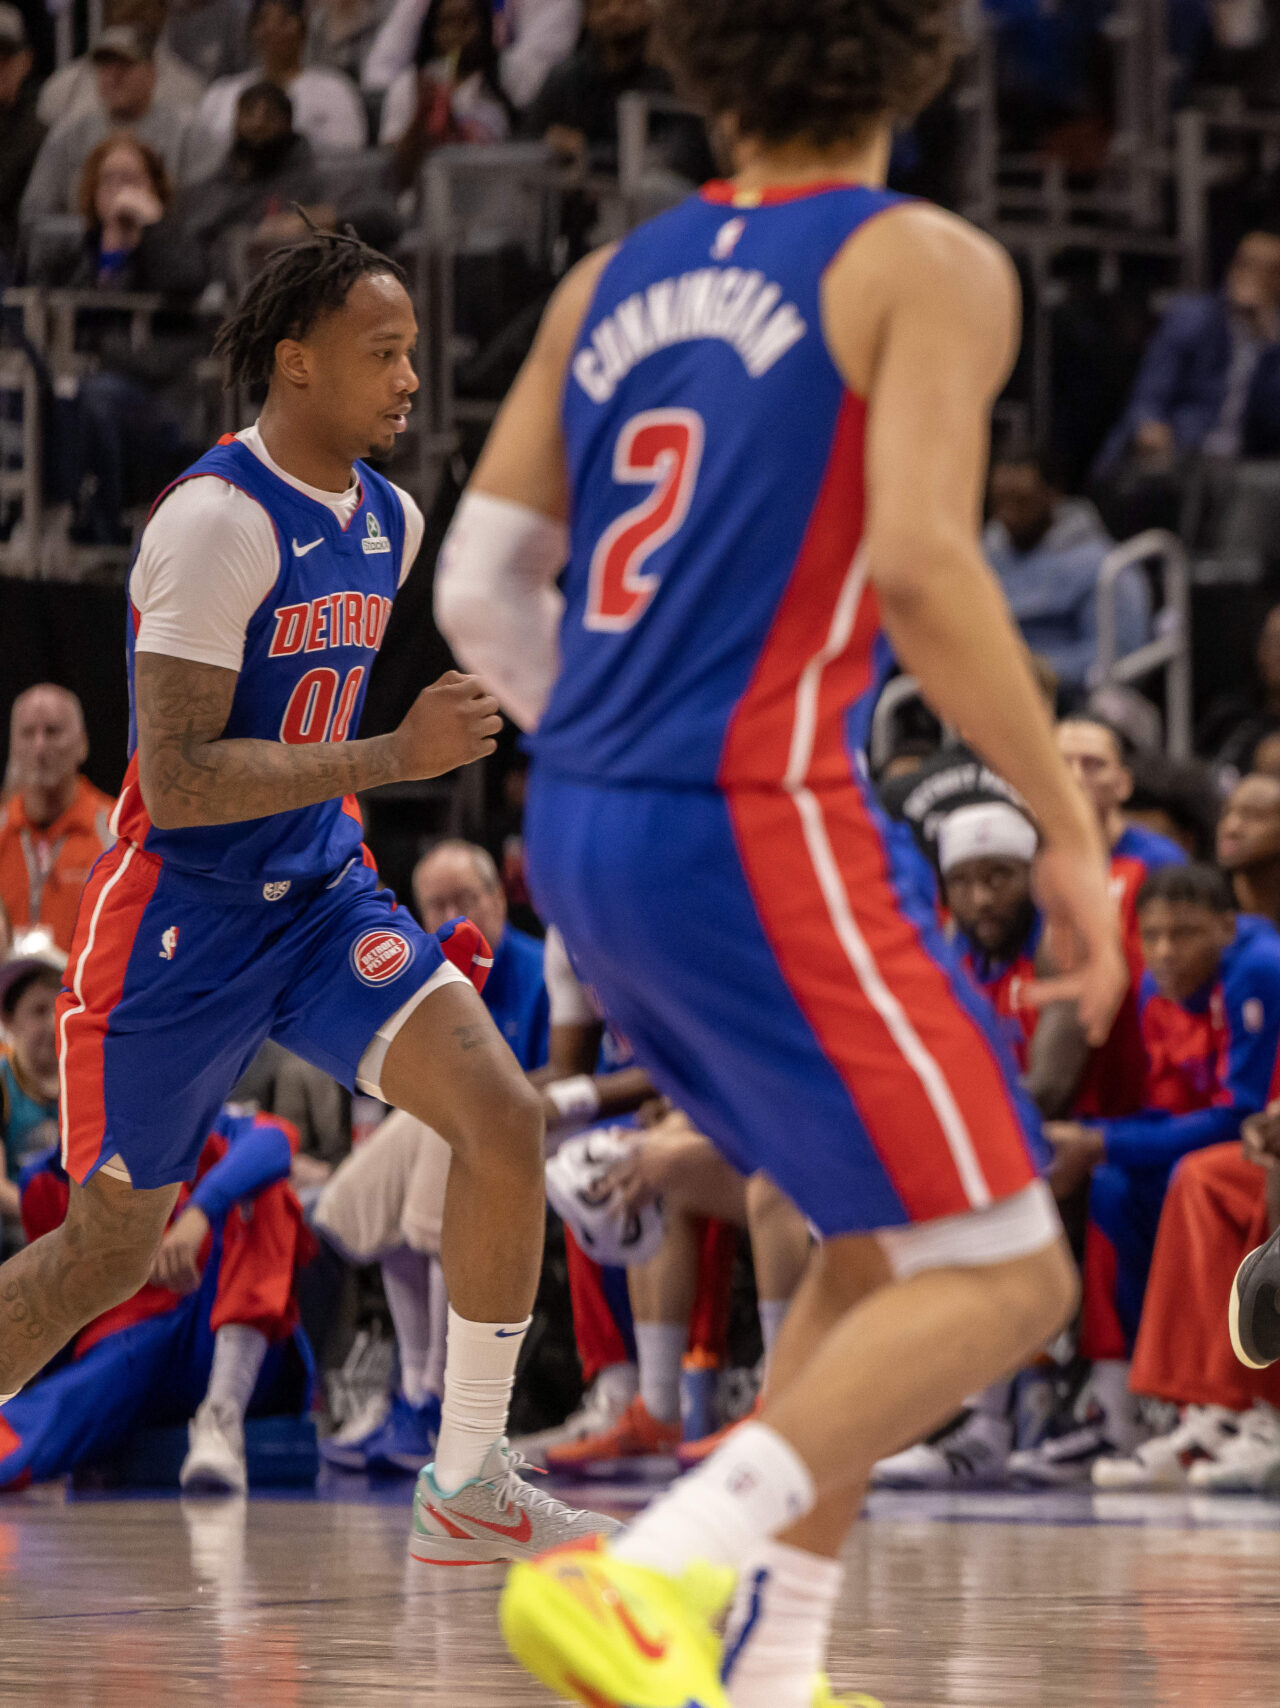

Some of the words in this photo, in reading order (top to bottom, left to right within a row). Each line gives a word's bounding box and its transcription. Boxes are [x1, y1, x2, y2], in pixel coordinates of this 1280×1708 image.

[573, 266, 807, 404] CUNNINGHAM
[583, 406, 706, 633] 2
[268, 591, 393, 658] DETROI
[279, 665, 365, 745] 00
[361, 938, 396, 966] DETROIT
[366, 945, 403, 974] PISTONS
